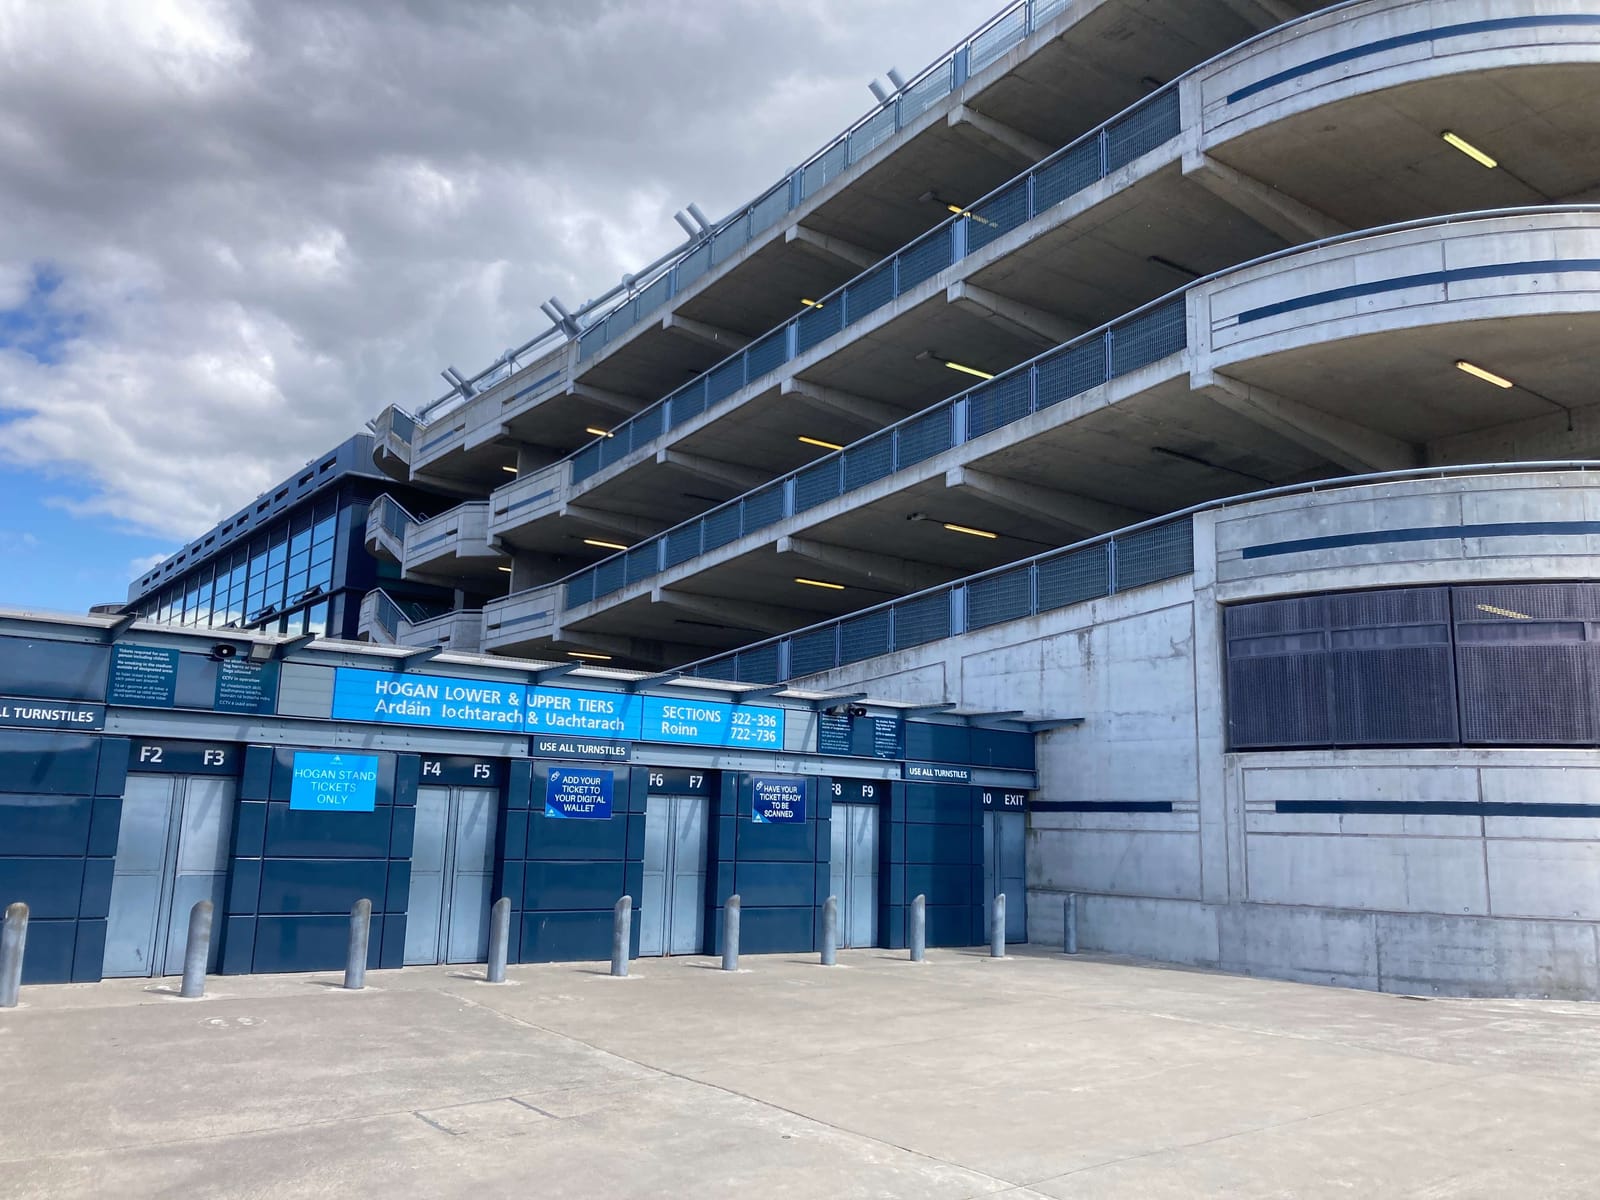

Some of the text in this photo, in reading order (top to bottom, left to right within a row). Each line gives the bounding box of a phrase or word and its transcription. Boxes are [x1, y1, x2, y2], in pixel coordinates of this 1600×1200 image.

[374, 680, 615, 714] HOGAN LOWER & UPPER TIERS
[14, 707, 94, 723] TURNSTILES
[374, 699, 625, 731] Ardáin Iochtarach & Uachtarach
[662, 705, 777, 728] SECTIONS 322-336
[661, 721, 776, 742] Roinn 722-736
[140, 746, 163, 763] F2
[540, 741, 626, 757] USE ALL TURNSTILES
[203, 749, 225, 766] F3
[294, 769, 376, 781] HOGAN STAND
[422, 761, 442, 777] F4
[473, 763, 491, 779] F5
[909, 767, 968, 779] USE ALL TURNSTILES
[562, 776, 601, 785] ADD YOUR
[649, 773, 664, 787] F6
[689, 775, 703, 789] F7
[311, 781, 357, 793] TICKETS
[562, 785, 601, 794] TICKET TO
[763, 785, 798, 794] HAVE YOUR
[862, 785, 874, 797] F9
[317, 794, 348, 804] ONLY
[554, 794, 606, 804] YOUR DIGITAL
[760, 793, 802, 802] TICKET READY
[1004, 794, 1025, 806] EXIT
[563, 804, 595, 812] WALLET
[771, 801, 780, 809] TO
[764, 810, 794, 818] SCANNED
